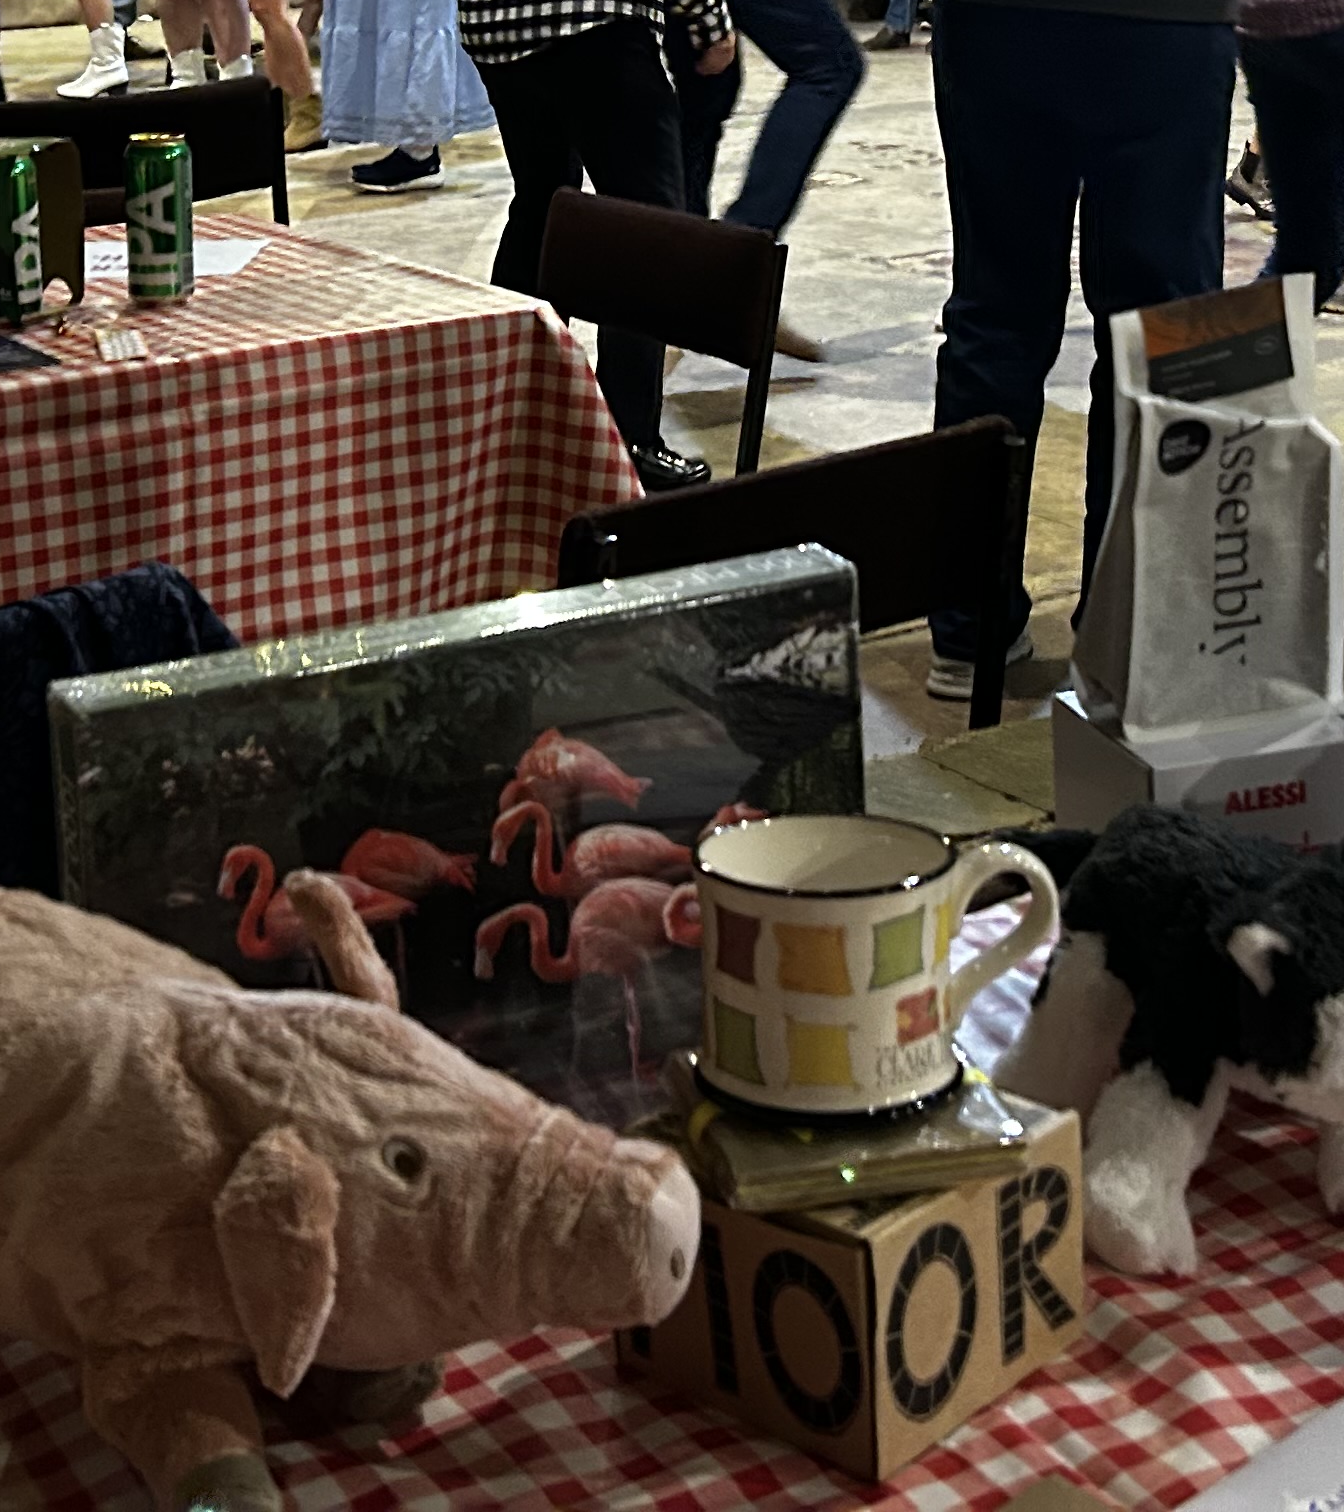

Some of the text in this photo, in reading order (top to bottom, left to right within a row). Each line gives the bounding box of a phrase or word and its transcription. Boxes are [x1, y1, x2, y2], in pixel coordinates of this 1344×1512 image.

[127, 180, 180, 286] IPA
[1199, 418, 1266, 667] Assembly
[1225, 779, 1308, 815] ALESSI
